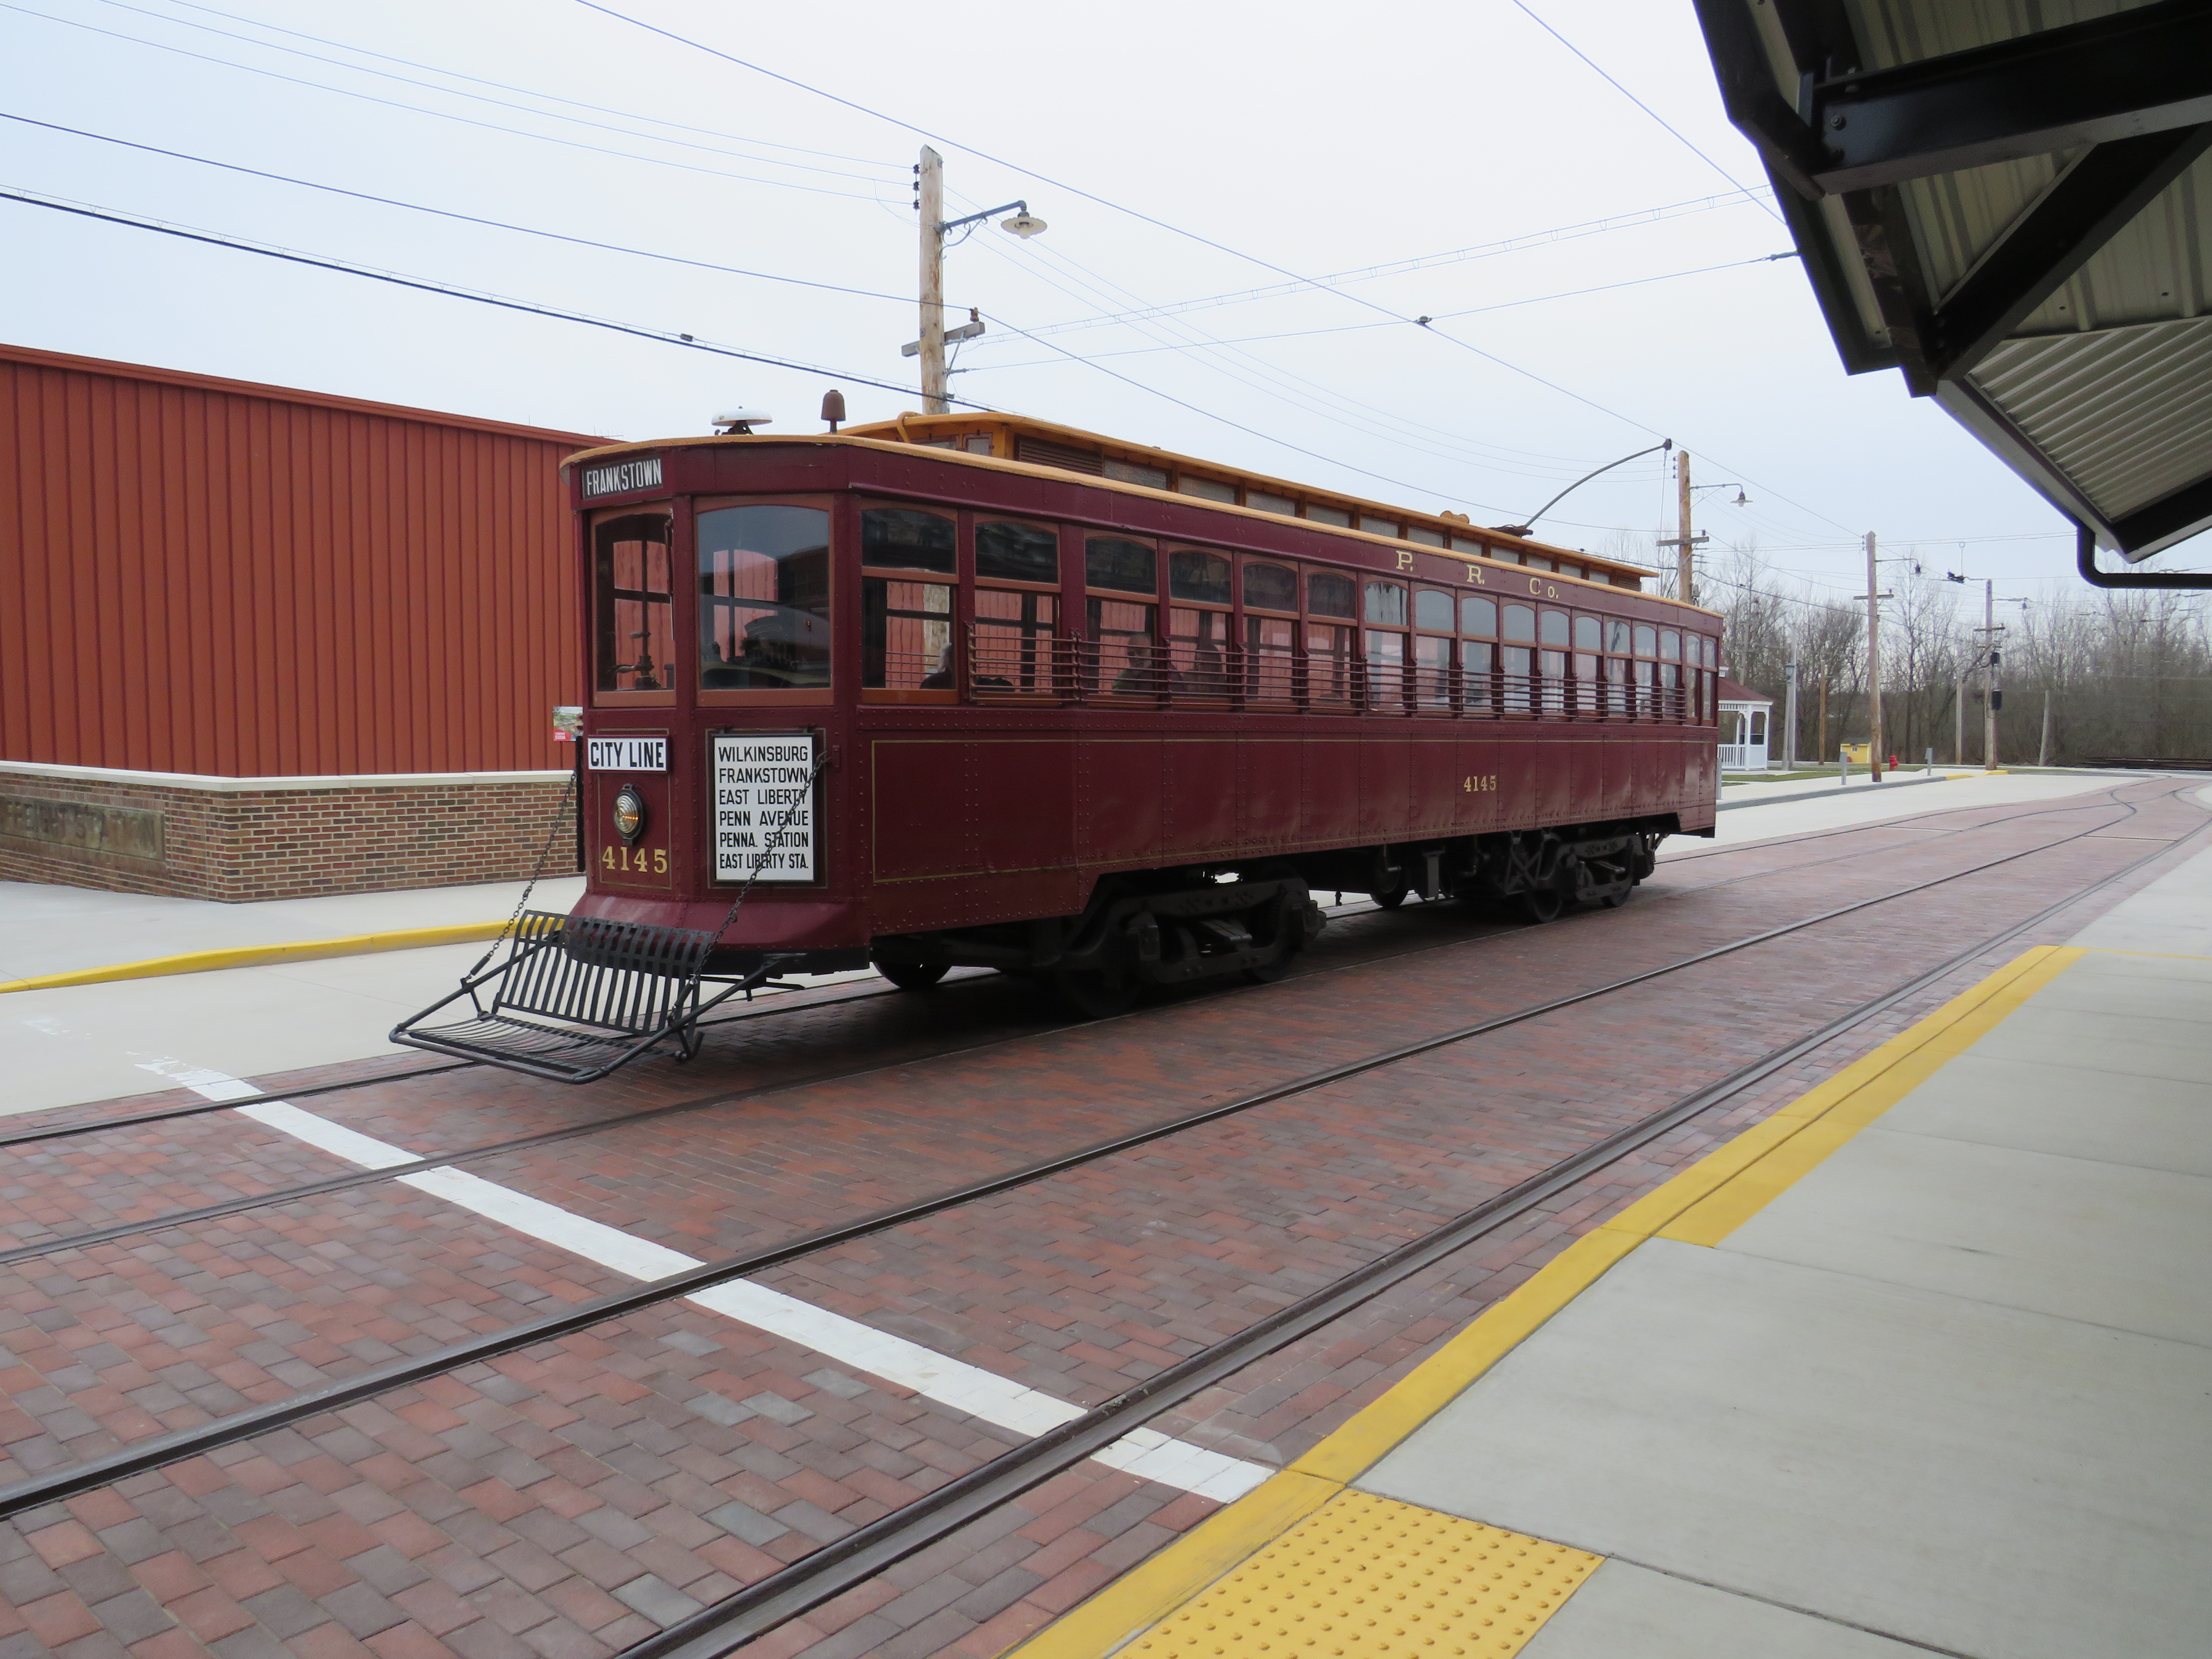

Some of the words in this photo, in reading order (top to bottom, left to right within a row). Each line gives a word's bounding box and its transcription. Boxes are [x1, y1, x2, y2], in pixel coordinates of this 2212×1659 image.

[586, 458, 662, 495] FRANKSTOWN
[1395, 550, 1413, 572] P.
[1466, 564, 1485, 585] R.
[1529, 577, 1558, 599] Co.
[591, 742, 623, 767] CITY
[629, 742, 664, 768] LINE
[718, 746, 808, 762] WILKINSBURG
[719, 767, 808, 783] FRANKSTOWN
[1464, 775, 1496, 792] 4145
[719, 789, 750, 805] EAST
[757, 789, 806, 805] LIBERTY
[719, 811, 751, 826] PENN
[759, 810, 809, 826] AVENUE
[720, 832, 758, 847] PENNA.
[765, 832, 809, 847] STATION
[602, 846, 668, 873] 4145
[720, 853, 743, 869] EAST
[747, 853, 785, 869] LIBERTY
[789, 853, 809, 869] STA.
